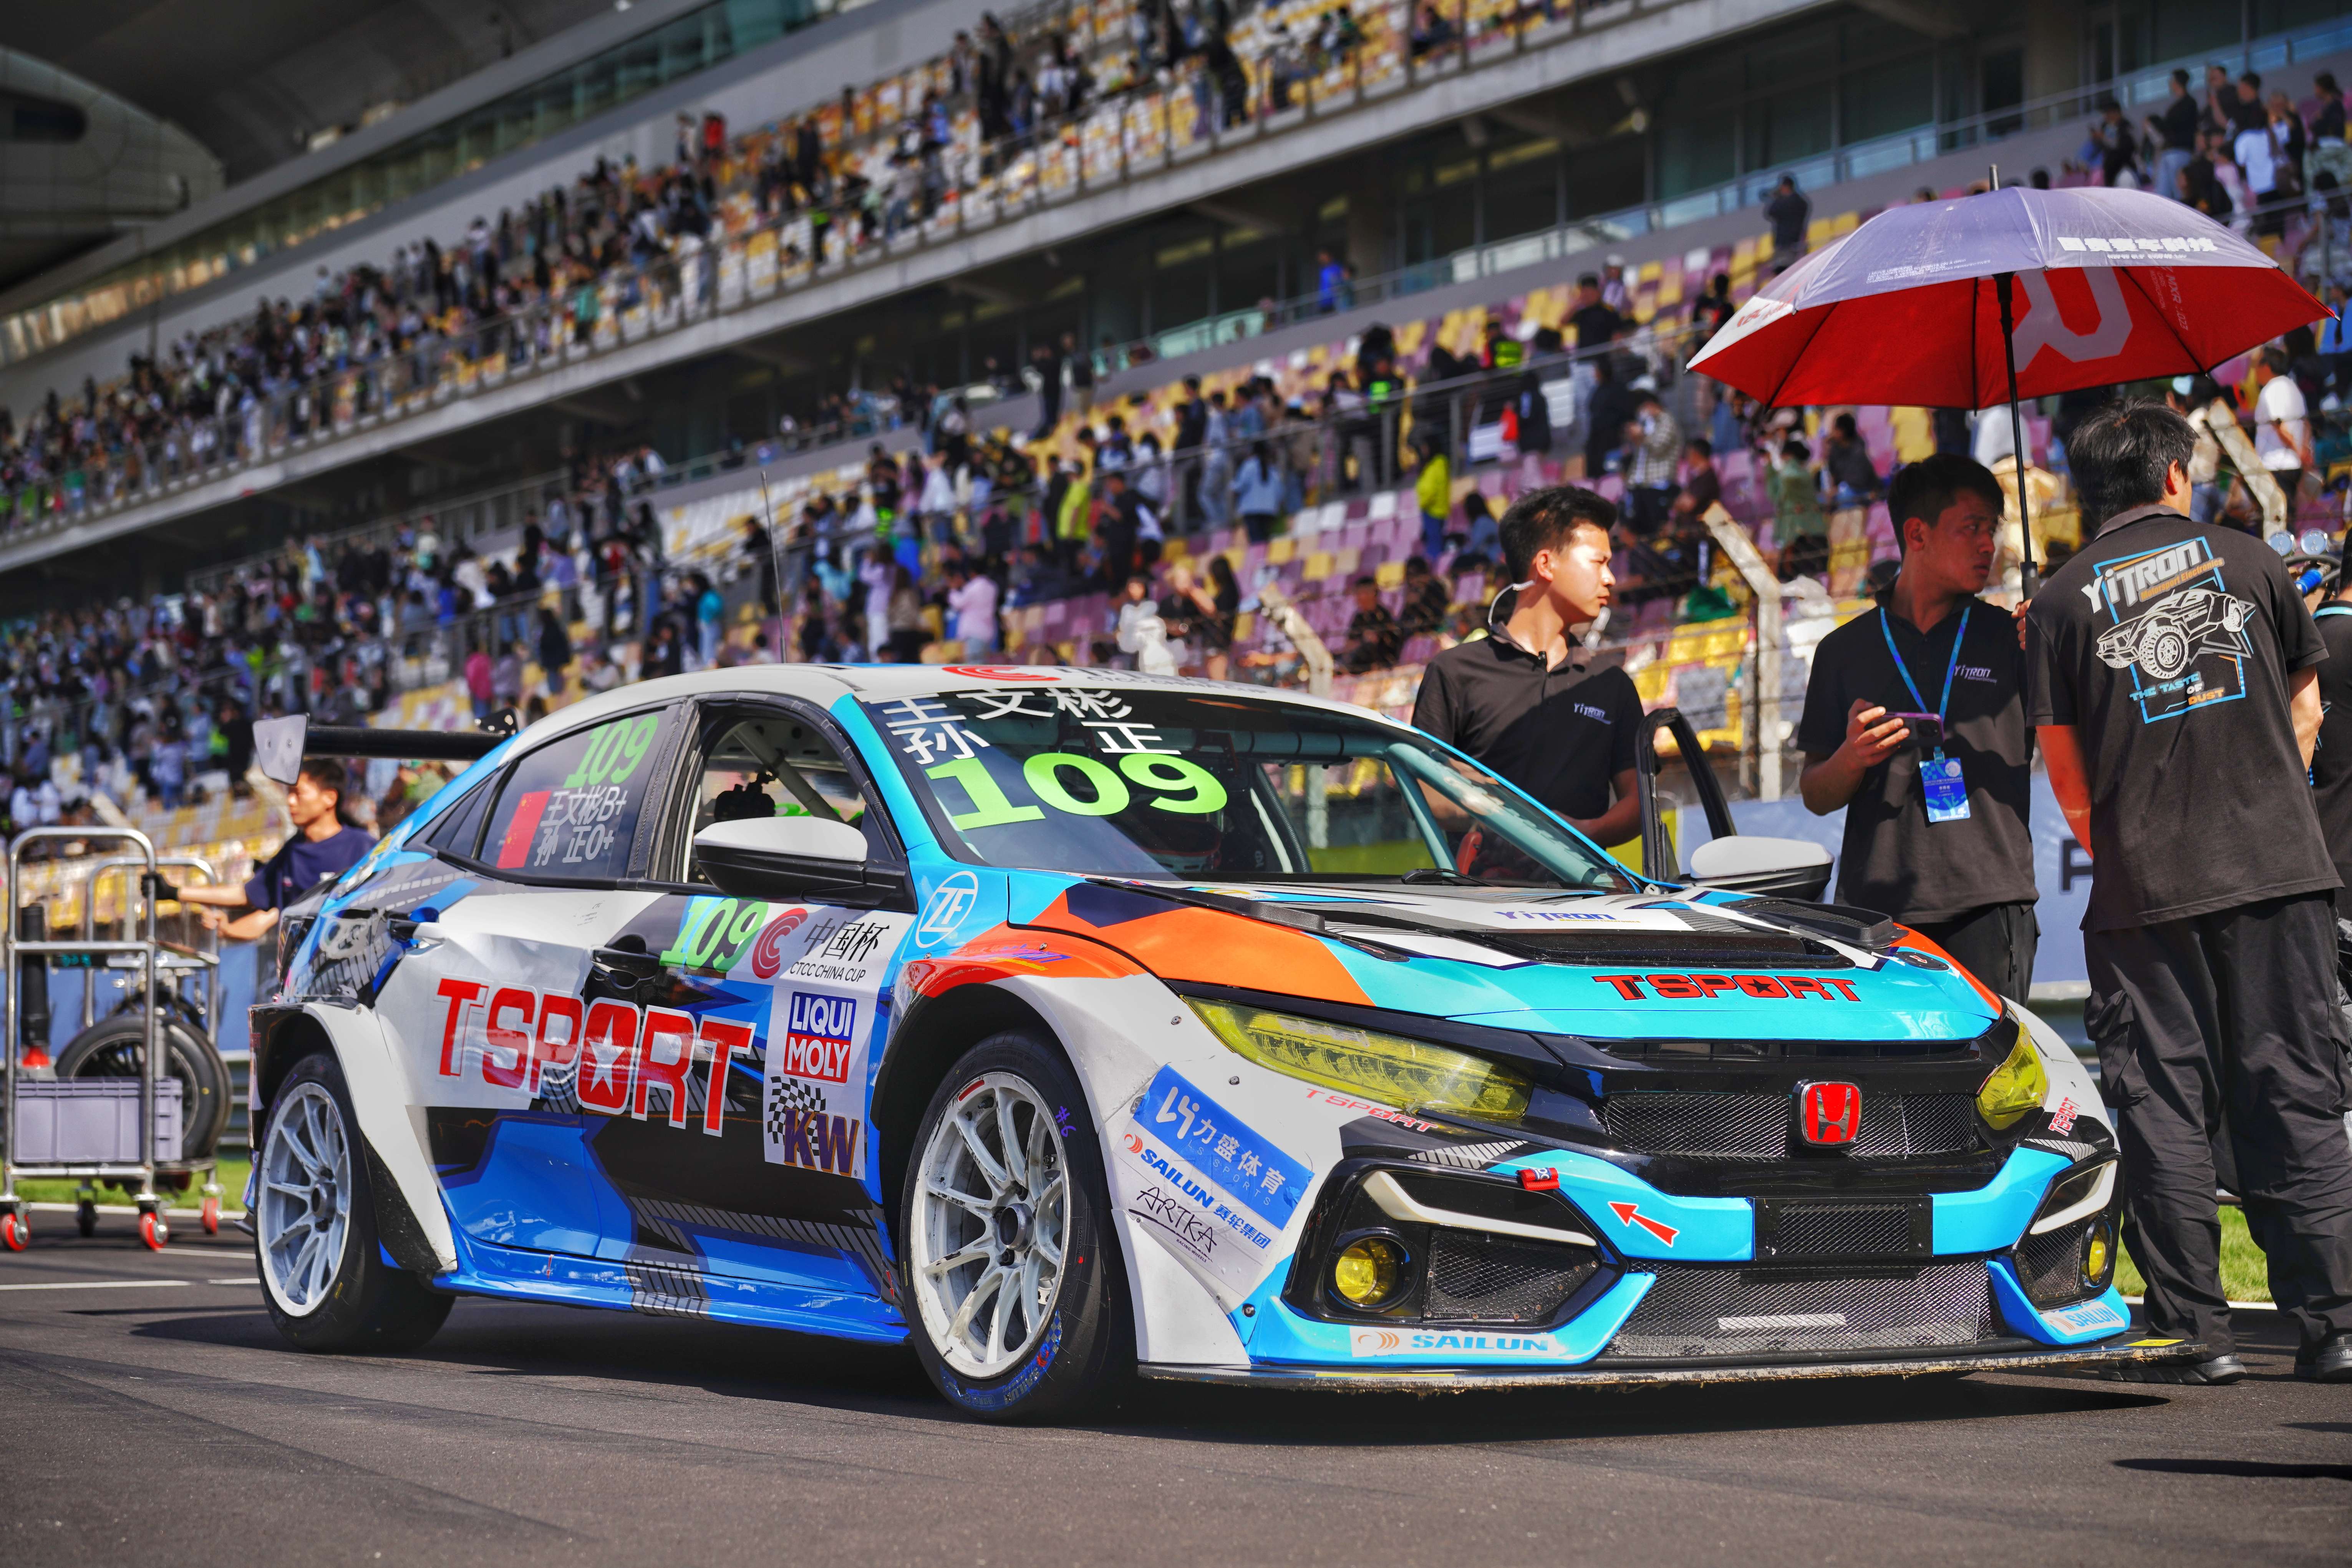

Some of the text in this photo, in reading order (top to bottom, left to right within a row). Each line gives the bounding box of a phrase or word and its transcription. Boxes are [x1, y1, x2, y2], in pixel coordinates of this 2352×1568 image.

[2140, 558, 2224, 602] Motorsport Electronics
[869, 687, 1132, 728] 王文彬
[2129, 673, 2200, 701] THE TASTE
[2186, 683, 2203, 694] OF
[2188, 688, 2225, 705] DUST
[564, 714, 658, 788] 109
[890, 721, 1182, 764] 孙 正
[925, 752, 1228, 830] 109
[920, 887, 975, 933] ZF
[659, 897, 769, 973] 109
[803, 918, 890, 963] 中国杯
[790, 961, 866, 983] CTCC CHINA CUP
[1593, 973, 1863, 1002] TSPORT
[791, 996, 853, 1037] LIQUI
[436, 978, 757, 1137] TSPORT
[787, 1037, 850, 1079] MOLY
[2048, 1096, 2081, 1137] TSPORT
[784, 1107, 860, 1177] KW
[1193, 1118, 1287, 1196] 力盛体育
[1140, 1149, 1272, 1250] SAILUN 赛轮集团
[1213, 1158, 1271, 1206] SPORTS
[1136, 1186, 1218, 1253] ARTKA
[2065, 1307, 2120, 1328] SAILUN
[1410, 1334, 1548, 1351] SAILUN
